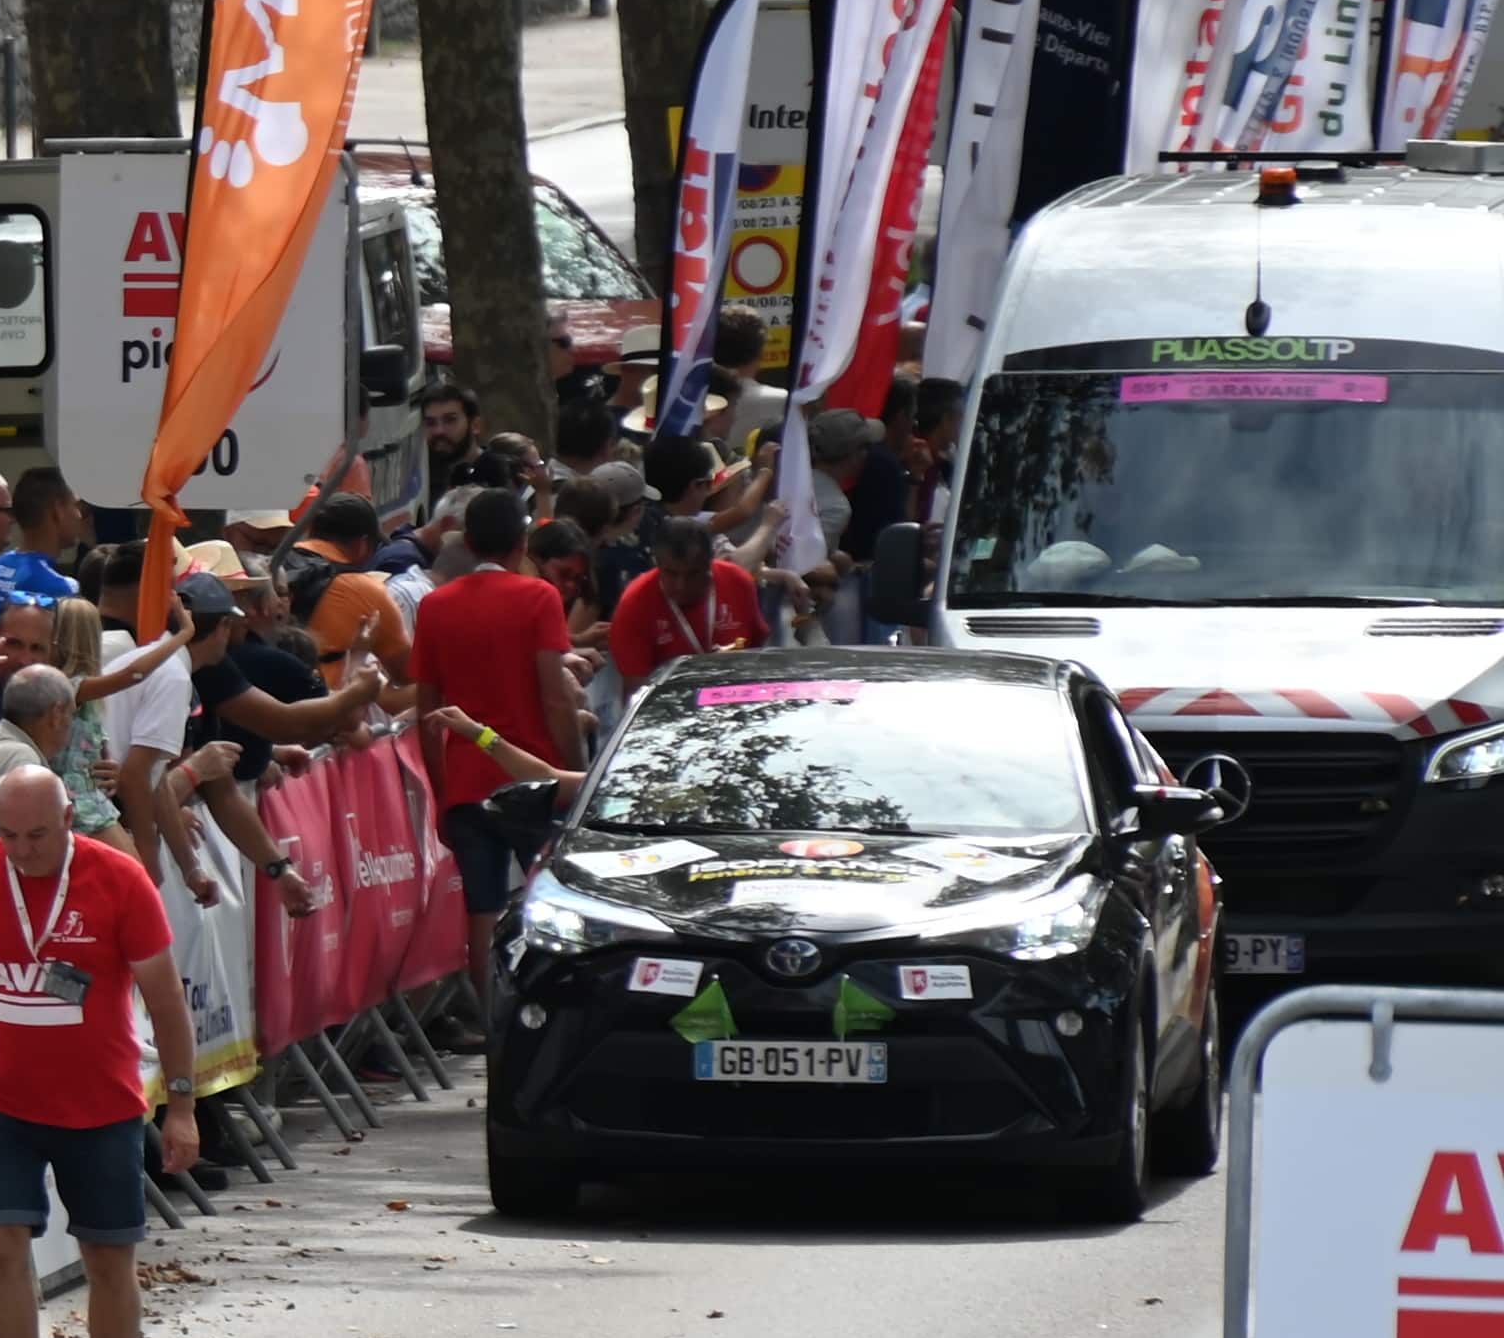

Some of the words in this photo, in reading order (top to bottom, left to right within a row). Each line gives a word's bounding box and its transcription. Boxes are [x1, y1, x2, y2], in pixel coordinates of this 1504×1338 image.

[1319, 82, 1347, 137] du
[1189, 383, 1318, 399] CARAVANE
[718, 1045, 865, 1077] GB-051-PV
